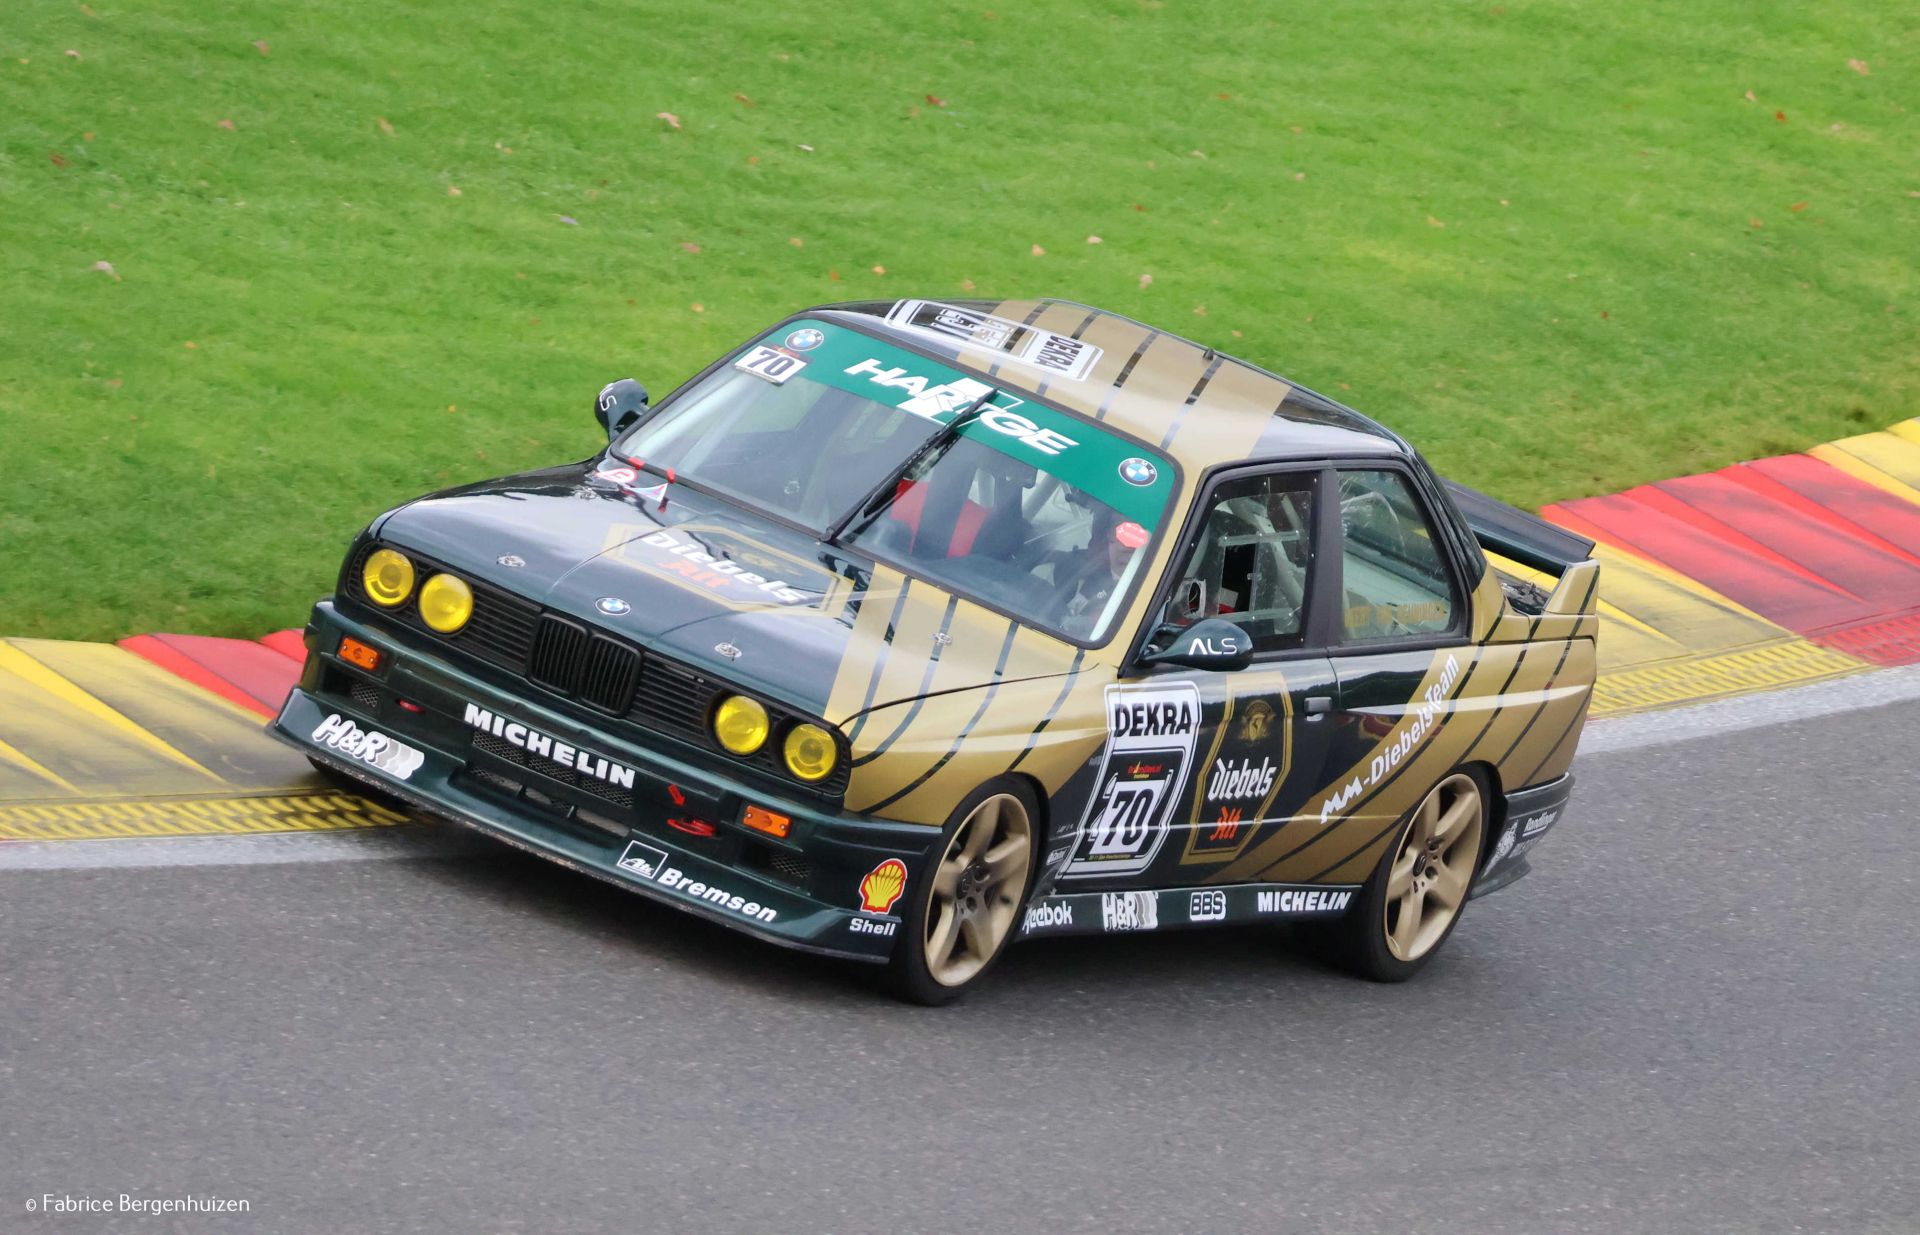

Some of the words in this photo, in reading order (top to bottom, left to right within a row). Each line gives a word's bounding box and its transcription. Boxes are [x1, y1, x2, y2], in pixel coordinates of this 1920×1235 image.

[747, 349, 796, 376] 70
[1034, 335, 1083, 371] DEKRA
[641, 531, 808, 602] Diebels
[1189, 638, 1237, 655] ALS
[1113, 701, 1192, 737] DEKRA
[312, 713, 389, 764] H&R
[464, 703, 636, 788] MICHELIN
[1208, 757, 1277, 801] Diebels
[1102, 789, 1154, 846] 70
[657, 868, 777, 922] Bremsen
[1102, 891, 1140, 930] H&R
[1190, 891, 1226, 921] BBS
[1257, 892, 1351, 912] MICHELIN
[849, 917, 897, 936] Shell
[1022, 901, 1072, 934] Reebok
